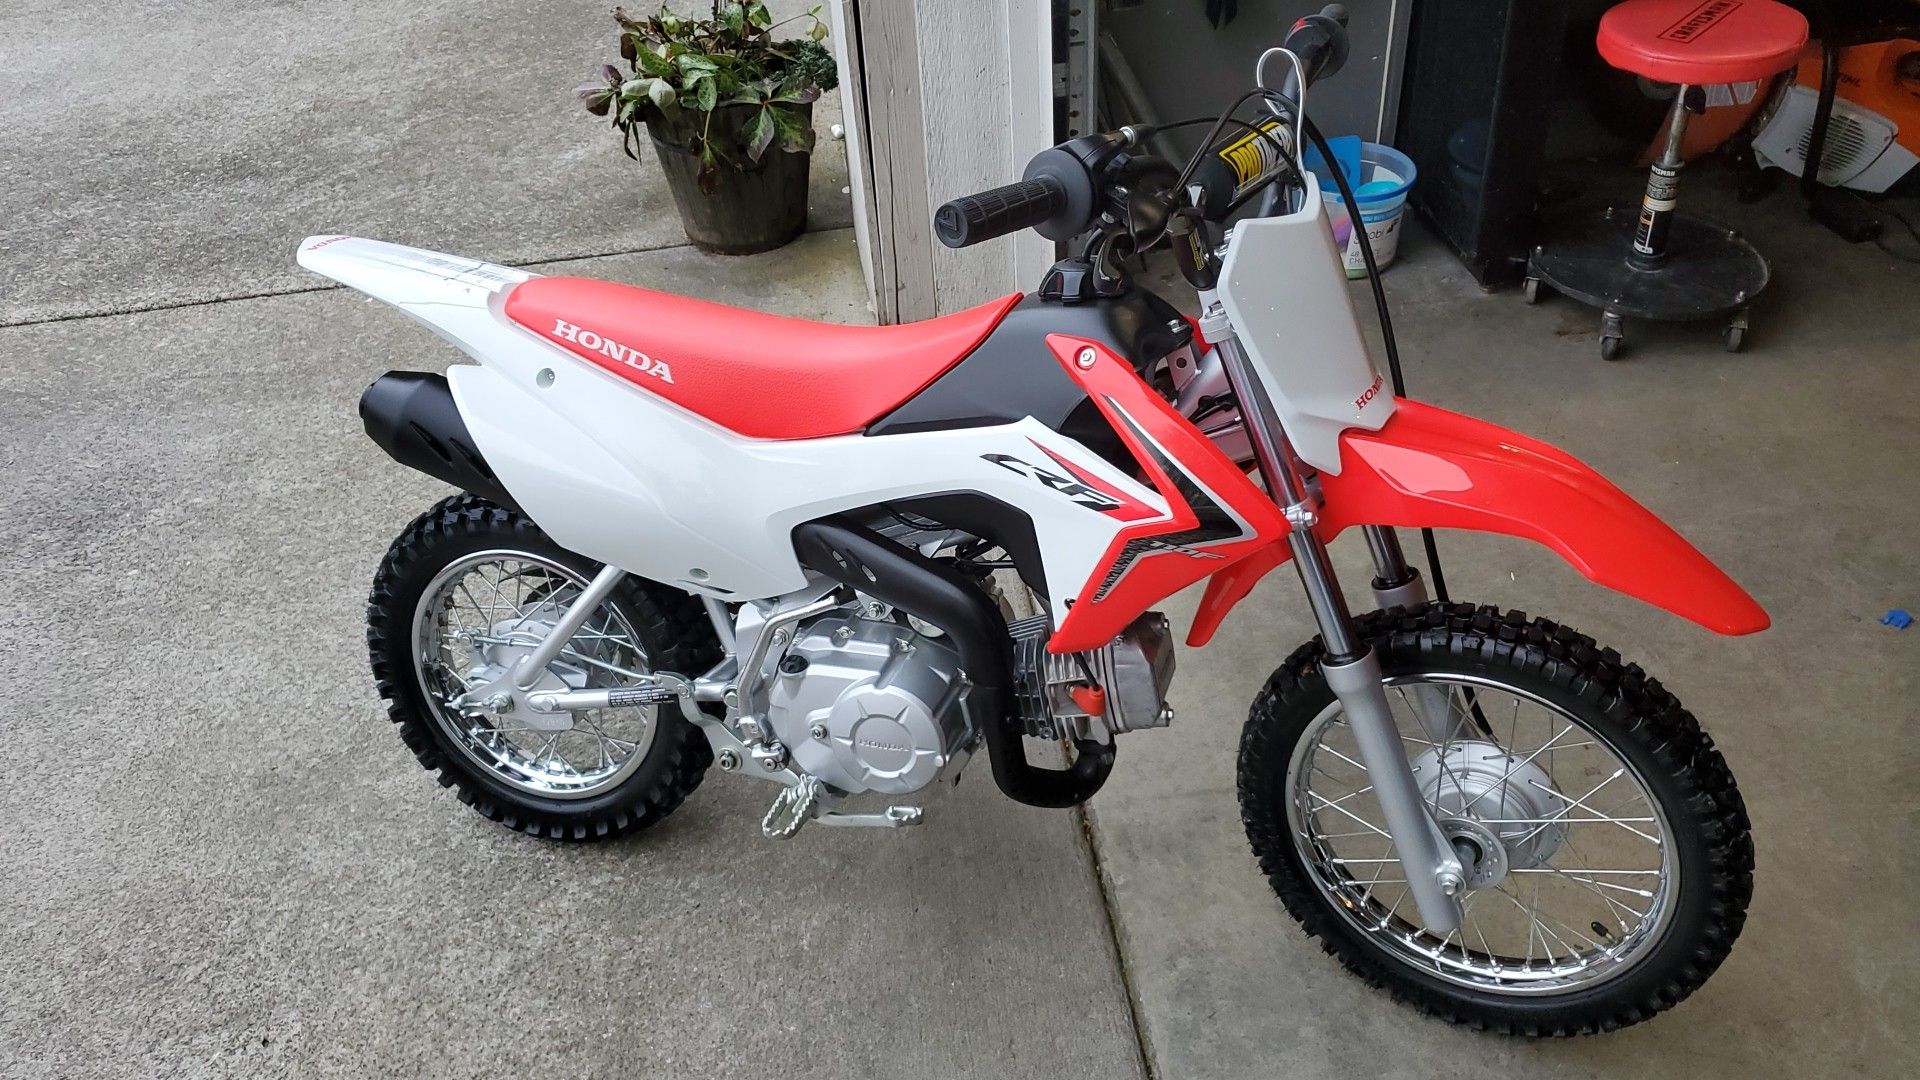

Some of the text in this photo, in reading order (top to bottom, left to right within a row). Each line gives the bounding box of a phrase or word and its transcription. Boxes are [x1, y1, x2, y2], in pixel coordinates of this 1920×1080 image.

[1669, 1, 1733, 39] CRAFTSMAN
[304, 236, 350, 251] ONDA
[552, 318, 675, 385] HONDA
[979, 453, 1120, 512] CRF
